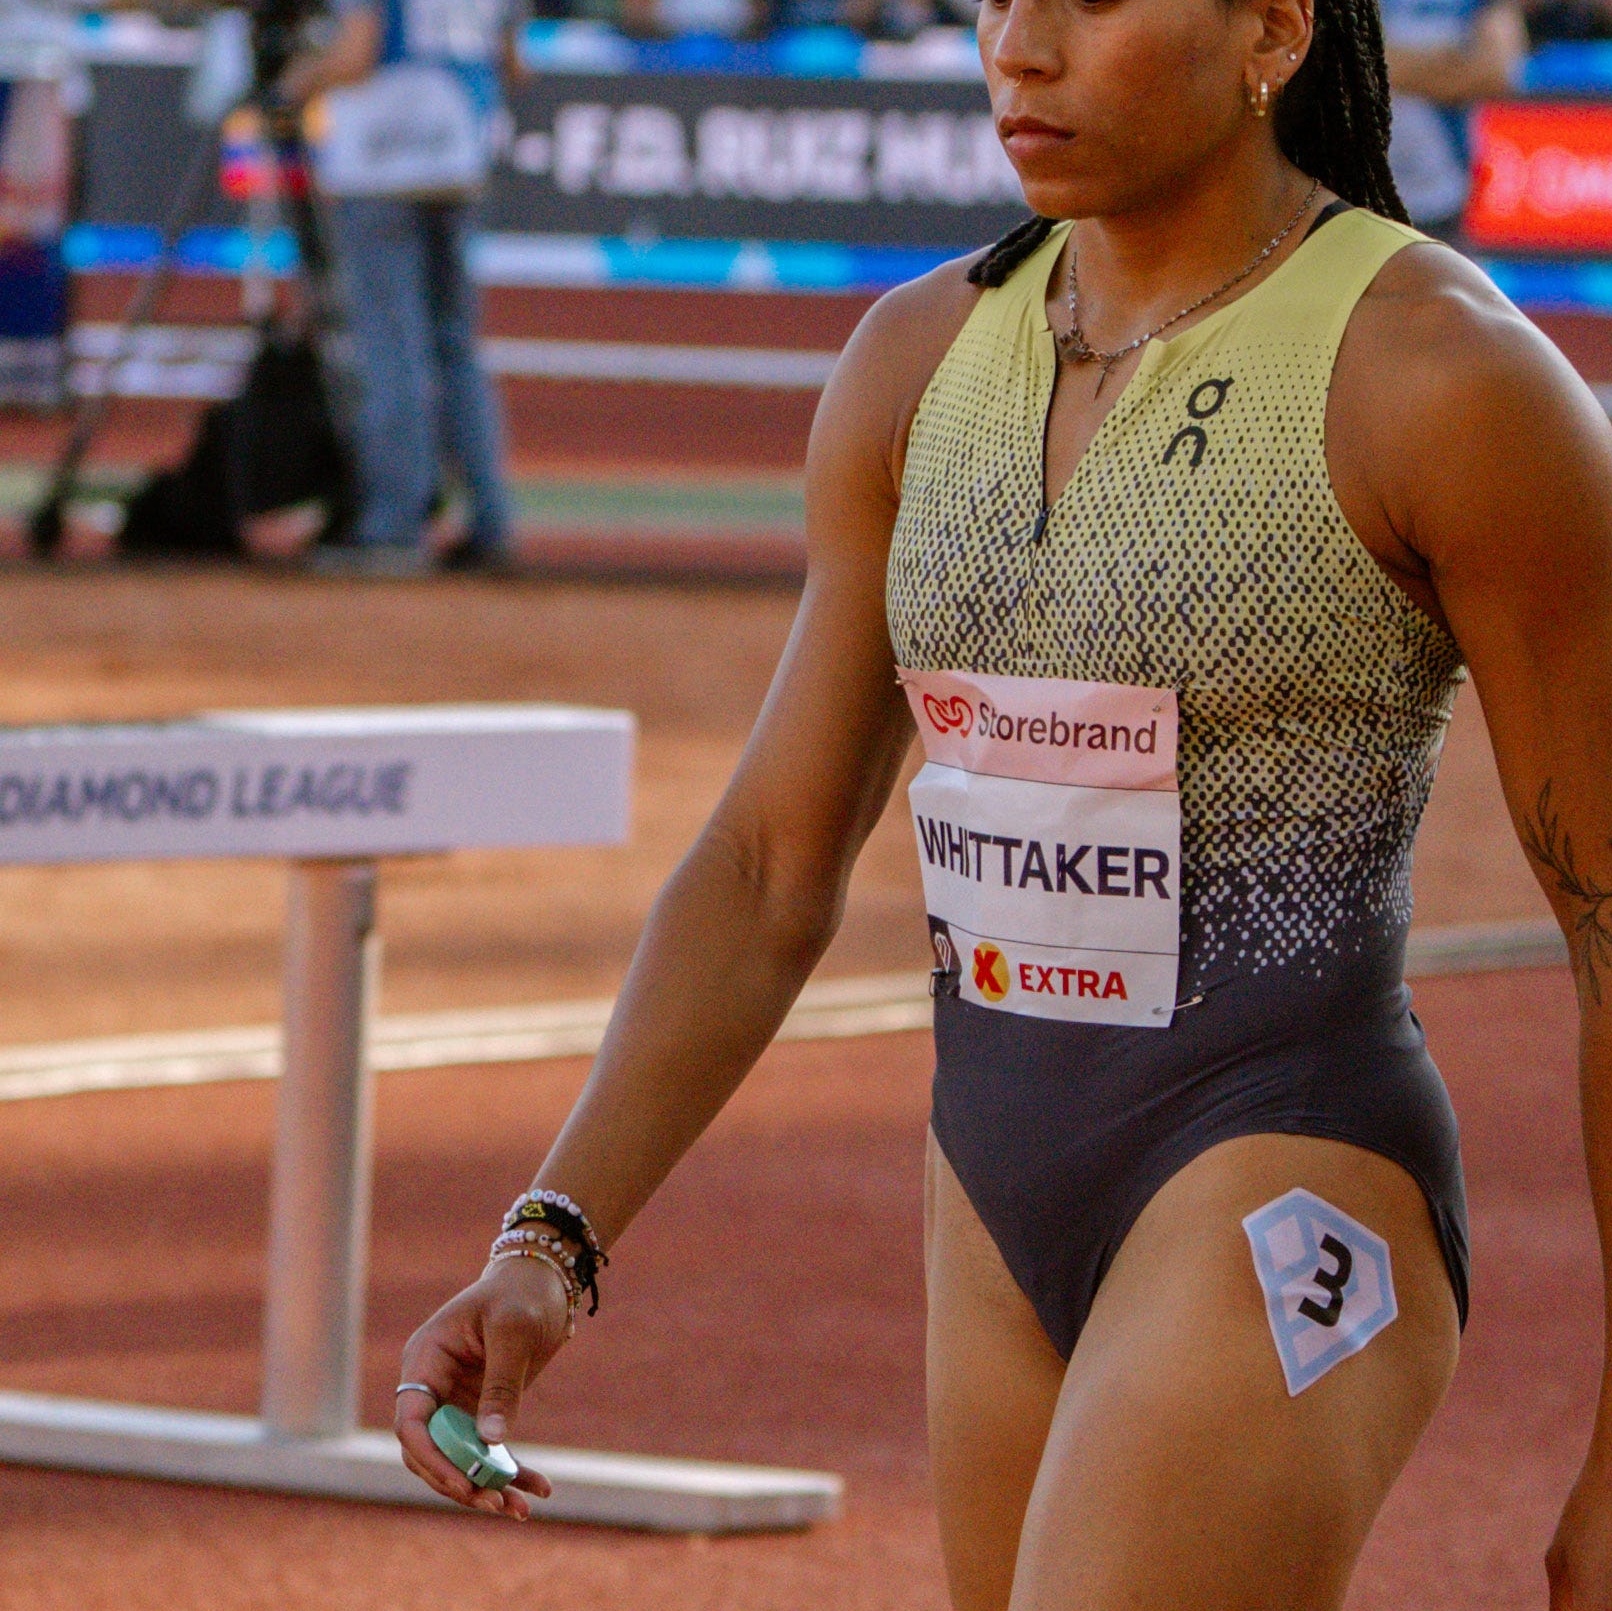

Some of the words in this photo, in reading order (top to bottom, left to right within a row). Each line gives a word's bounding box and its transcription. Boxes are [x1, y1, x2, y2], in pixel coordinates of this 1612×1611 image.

[978, 701, 1157, 754] Storebrand
[0, 769, 217, 826] DIAMOND
[229, 759, 414, 818] LEAGUE
[917, 814, 1172, 900] WHITTAKER
[1018, 962, 1128, 1001] EXTRA
[1297, 1233, 1353, 1328] 3
